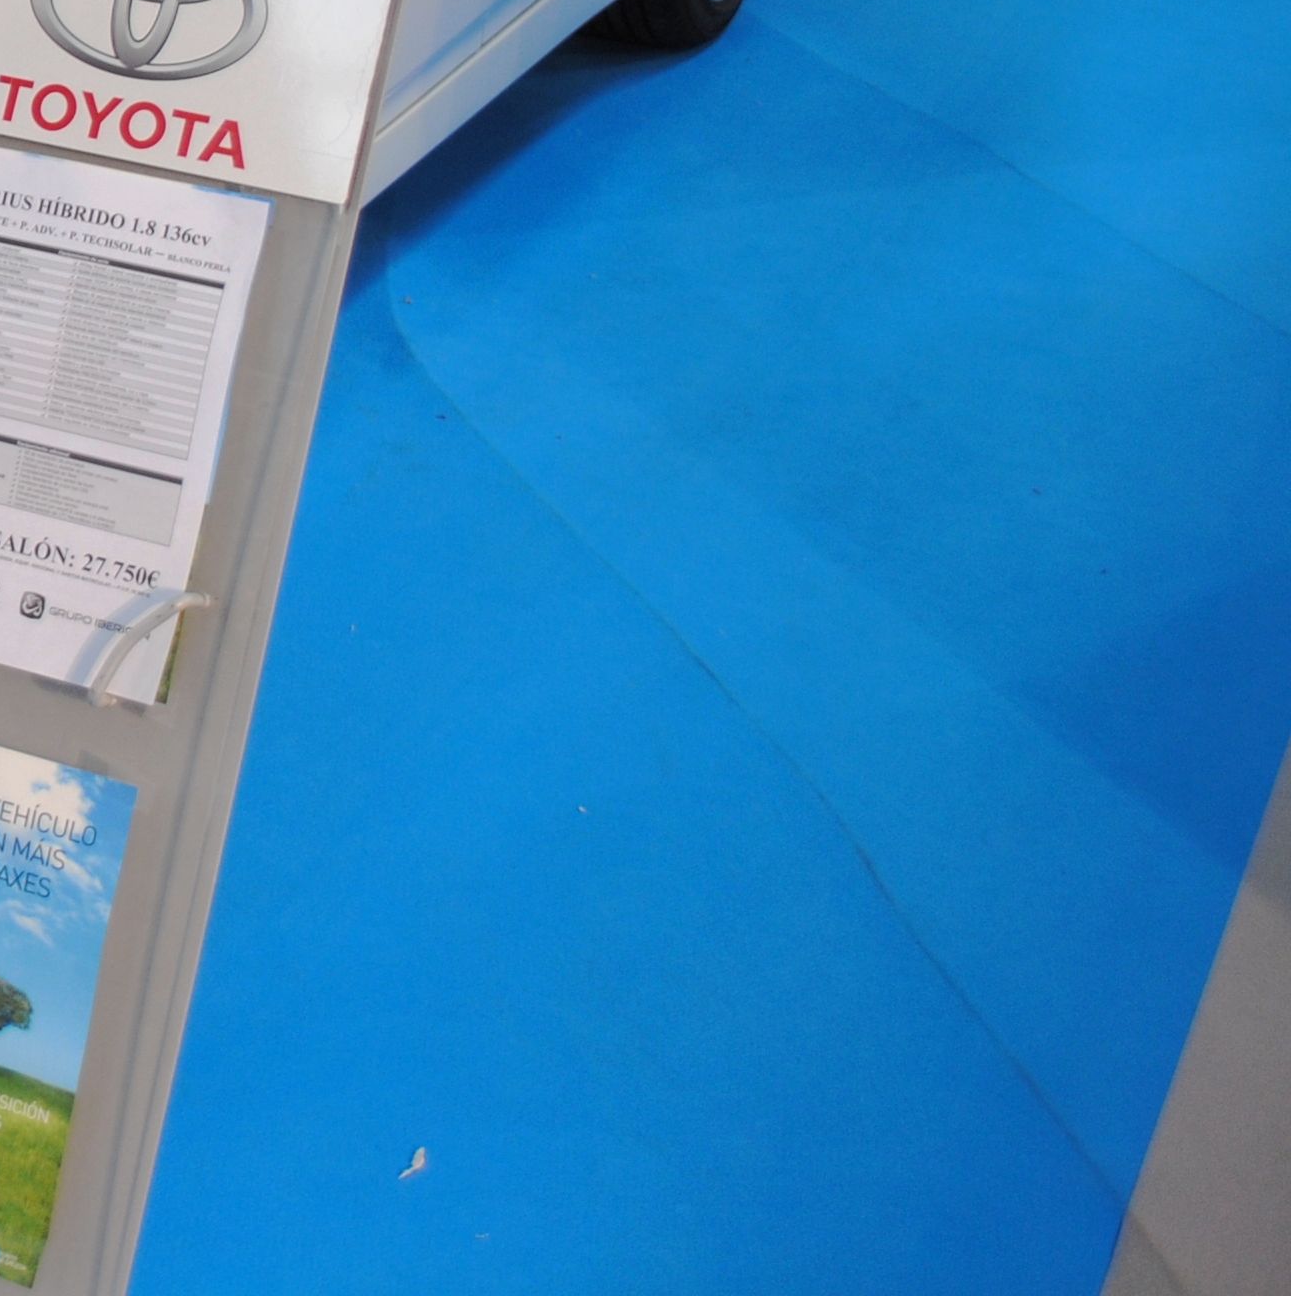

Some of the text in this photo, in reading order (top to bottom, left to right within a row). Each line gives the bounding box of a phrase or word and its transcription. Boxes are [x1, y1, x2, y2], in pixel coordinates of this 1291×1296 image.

[36, 193, 128, 230] HÍBRIDO
[130, 217, 157, 236] 1.8
[160, 223, 212, 248] 136cv
[30, 223, 59, 238] ADV.
[80, 233, 152, 257] TECHSOLAR
[80, 552, 162, 590] 27.750€
[48, 605, 92, 625] GRUPO
[11, 832, 68, 871] MÁIS
